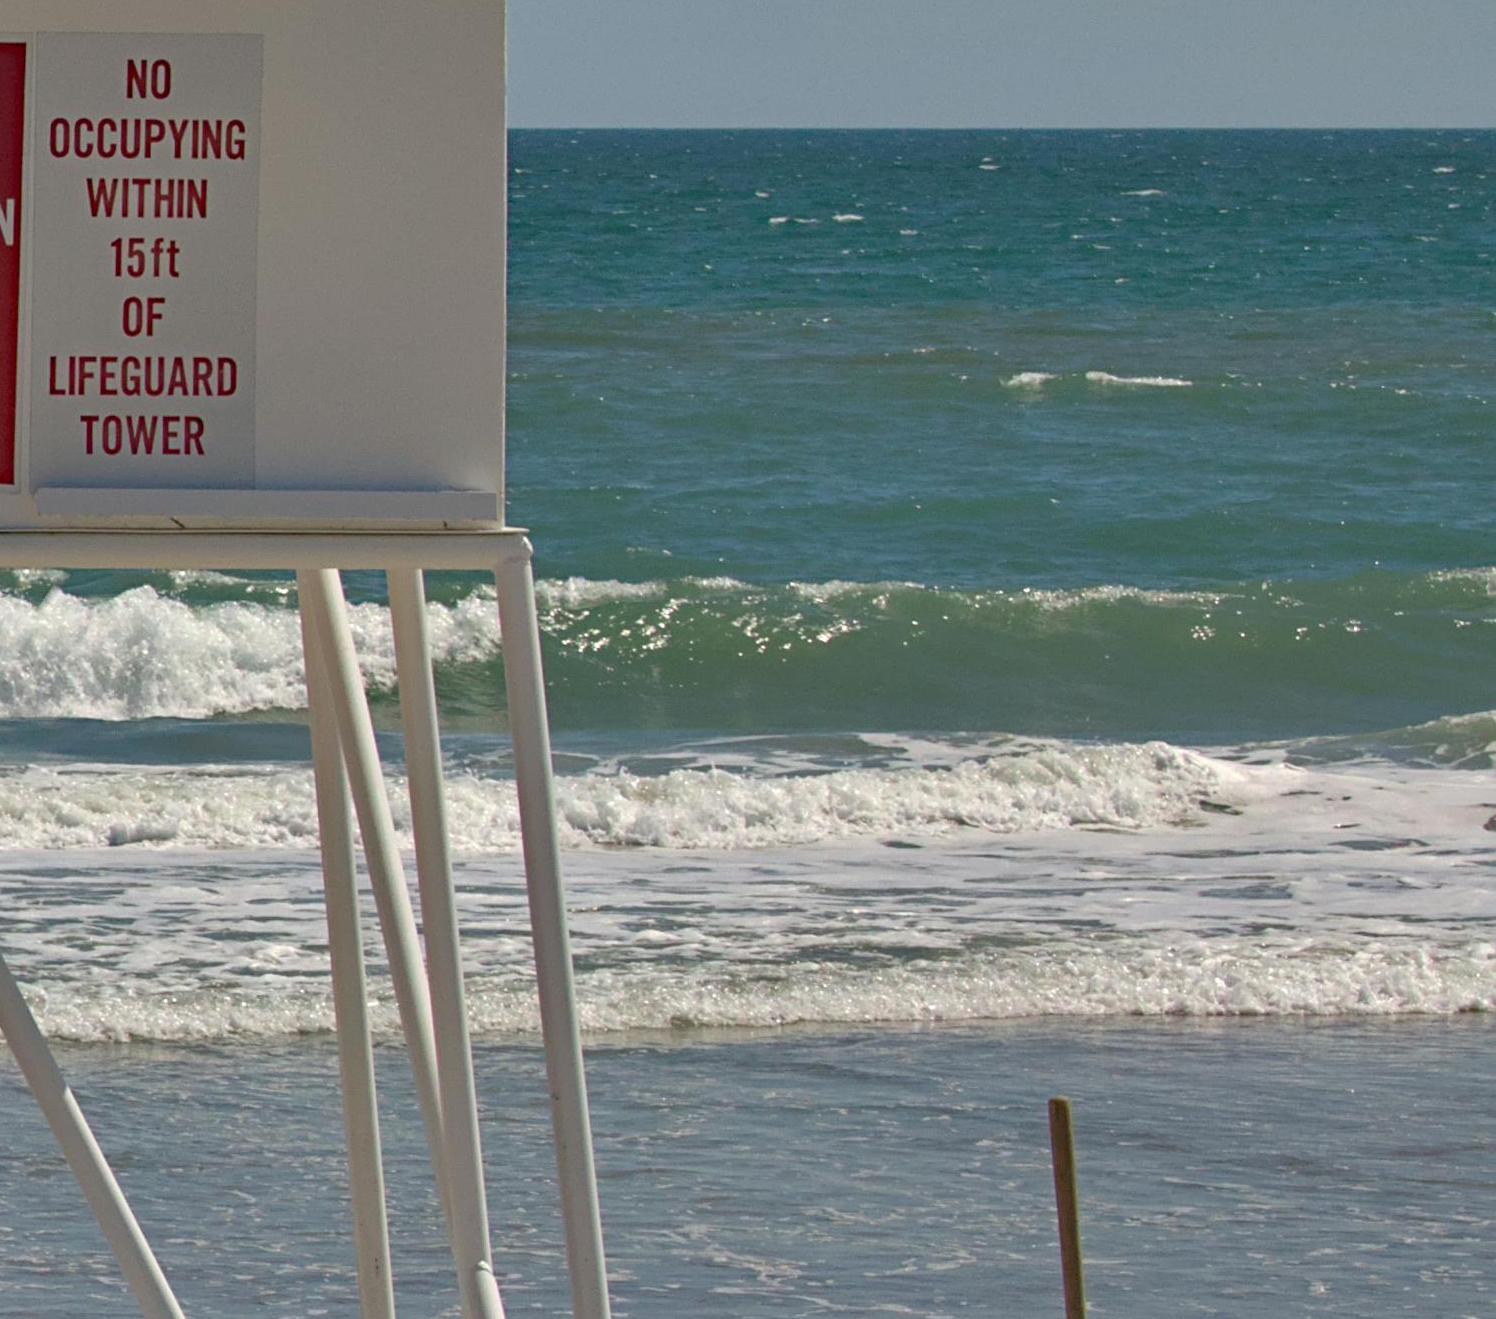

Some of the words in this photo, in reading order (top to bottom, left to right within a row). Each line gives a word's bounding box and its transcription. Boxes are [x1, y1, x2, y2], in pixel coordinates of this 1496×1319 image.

[125, 59, 173, 100] NO
[49, 117, 248, 161] OCCUPYING
[85, 178, 208, 219] WITHIN
[110, 236, 182, 280] 15ft
[121, 295, 166, 338] OF
[48, 355, 239, 399] LIFEGUARD
[79, 414, 206, 457] TOWER
